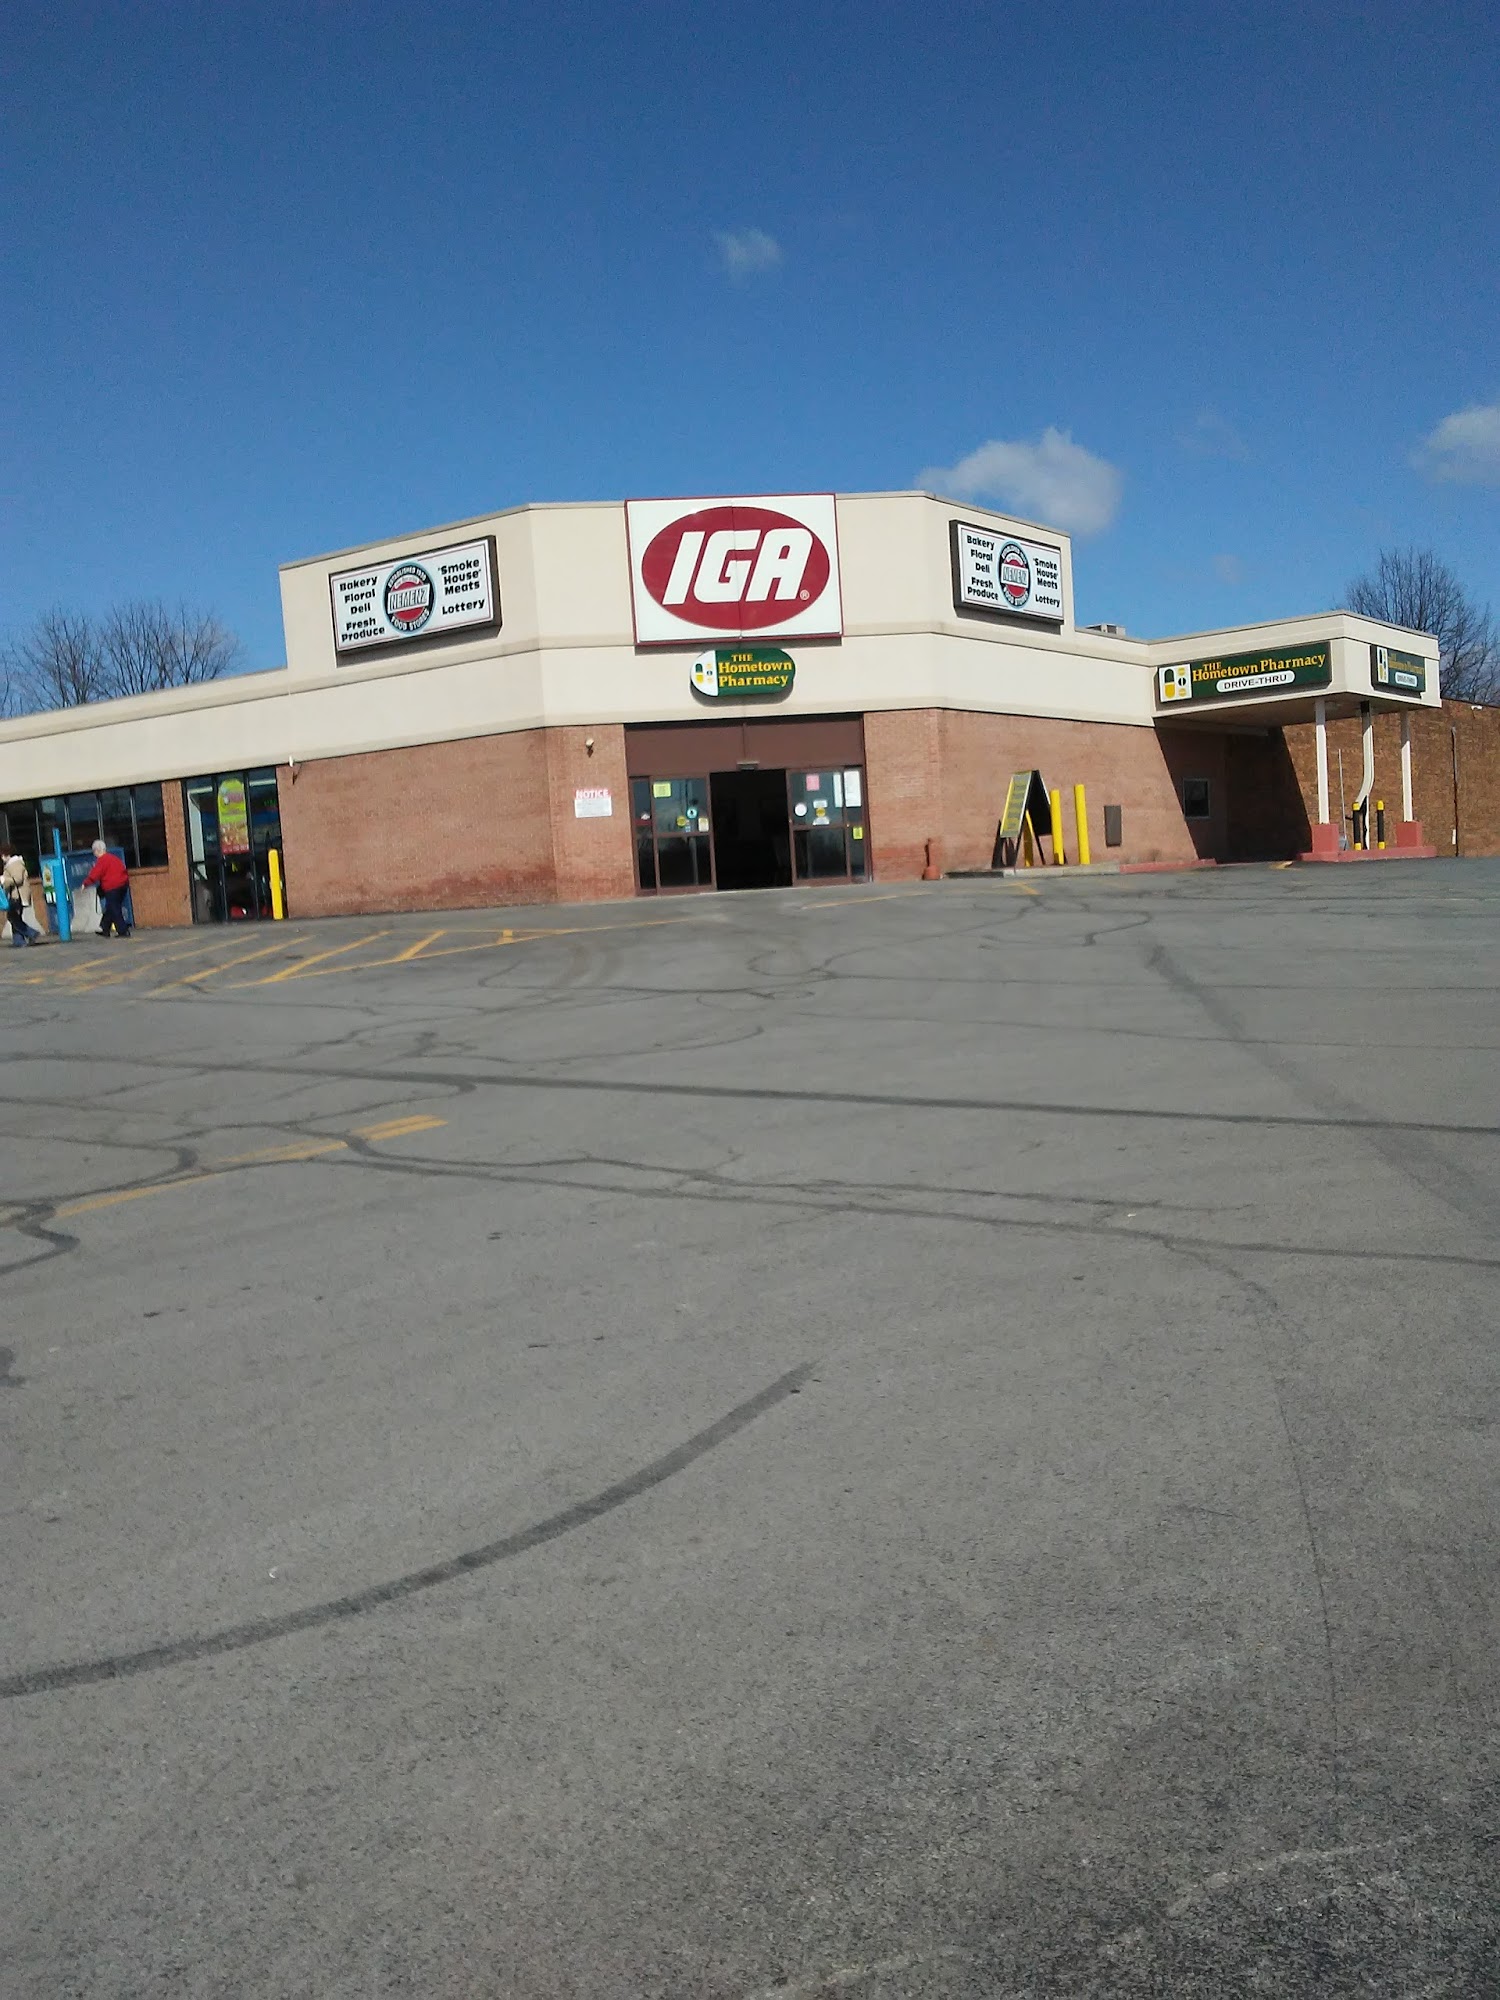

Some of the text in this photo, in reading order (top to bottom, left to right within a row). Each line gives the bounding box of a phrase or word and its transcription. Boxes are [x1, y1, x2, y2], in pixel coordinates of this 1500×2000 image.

[966, 535, 994, 551] Bakery
[970, 549, 993, 562] Floral
[662, 527, 813, 605] IGA
[975, 562, 990, 574] Deli
[339, 575, 378, 592] Bakery
[444, 581, 480, 596] Meats
[971, 577, 994, 589] Fresh
[1037, 577, 1058, 590] Meats
[344, 588, 376, 604] Floral
[967, 586, 998, 601] Produce
[442, 598, 485, 616] Lottery
[1035, 594, 1060, 608] Lottery
[350, 603, 371, 615] Deli
[346, 617, 376, 631] Fresh
[391, 615, 408, 631] FOOD
[341, 626, 385, 643] Produce
[731, 653, 753, 662] THE
[717, 660, 793, 674] Hometown
[1192, 654, 1325, 682] Hometown Pharmacy
[1203, 662, 1221, 672] THE
[718, 674, 789, 687] Pharmacy
[1224, 674, 1287, 690] DRIVE-THRU
